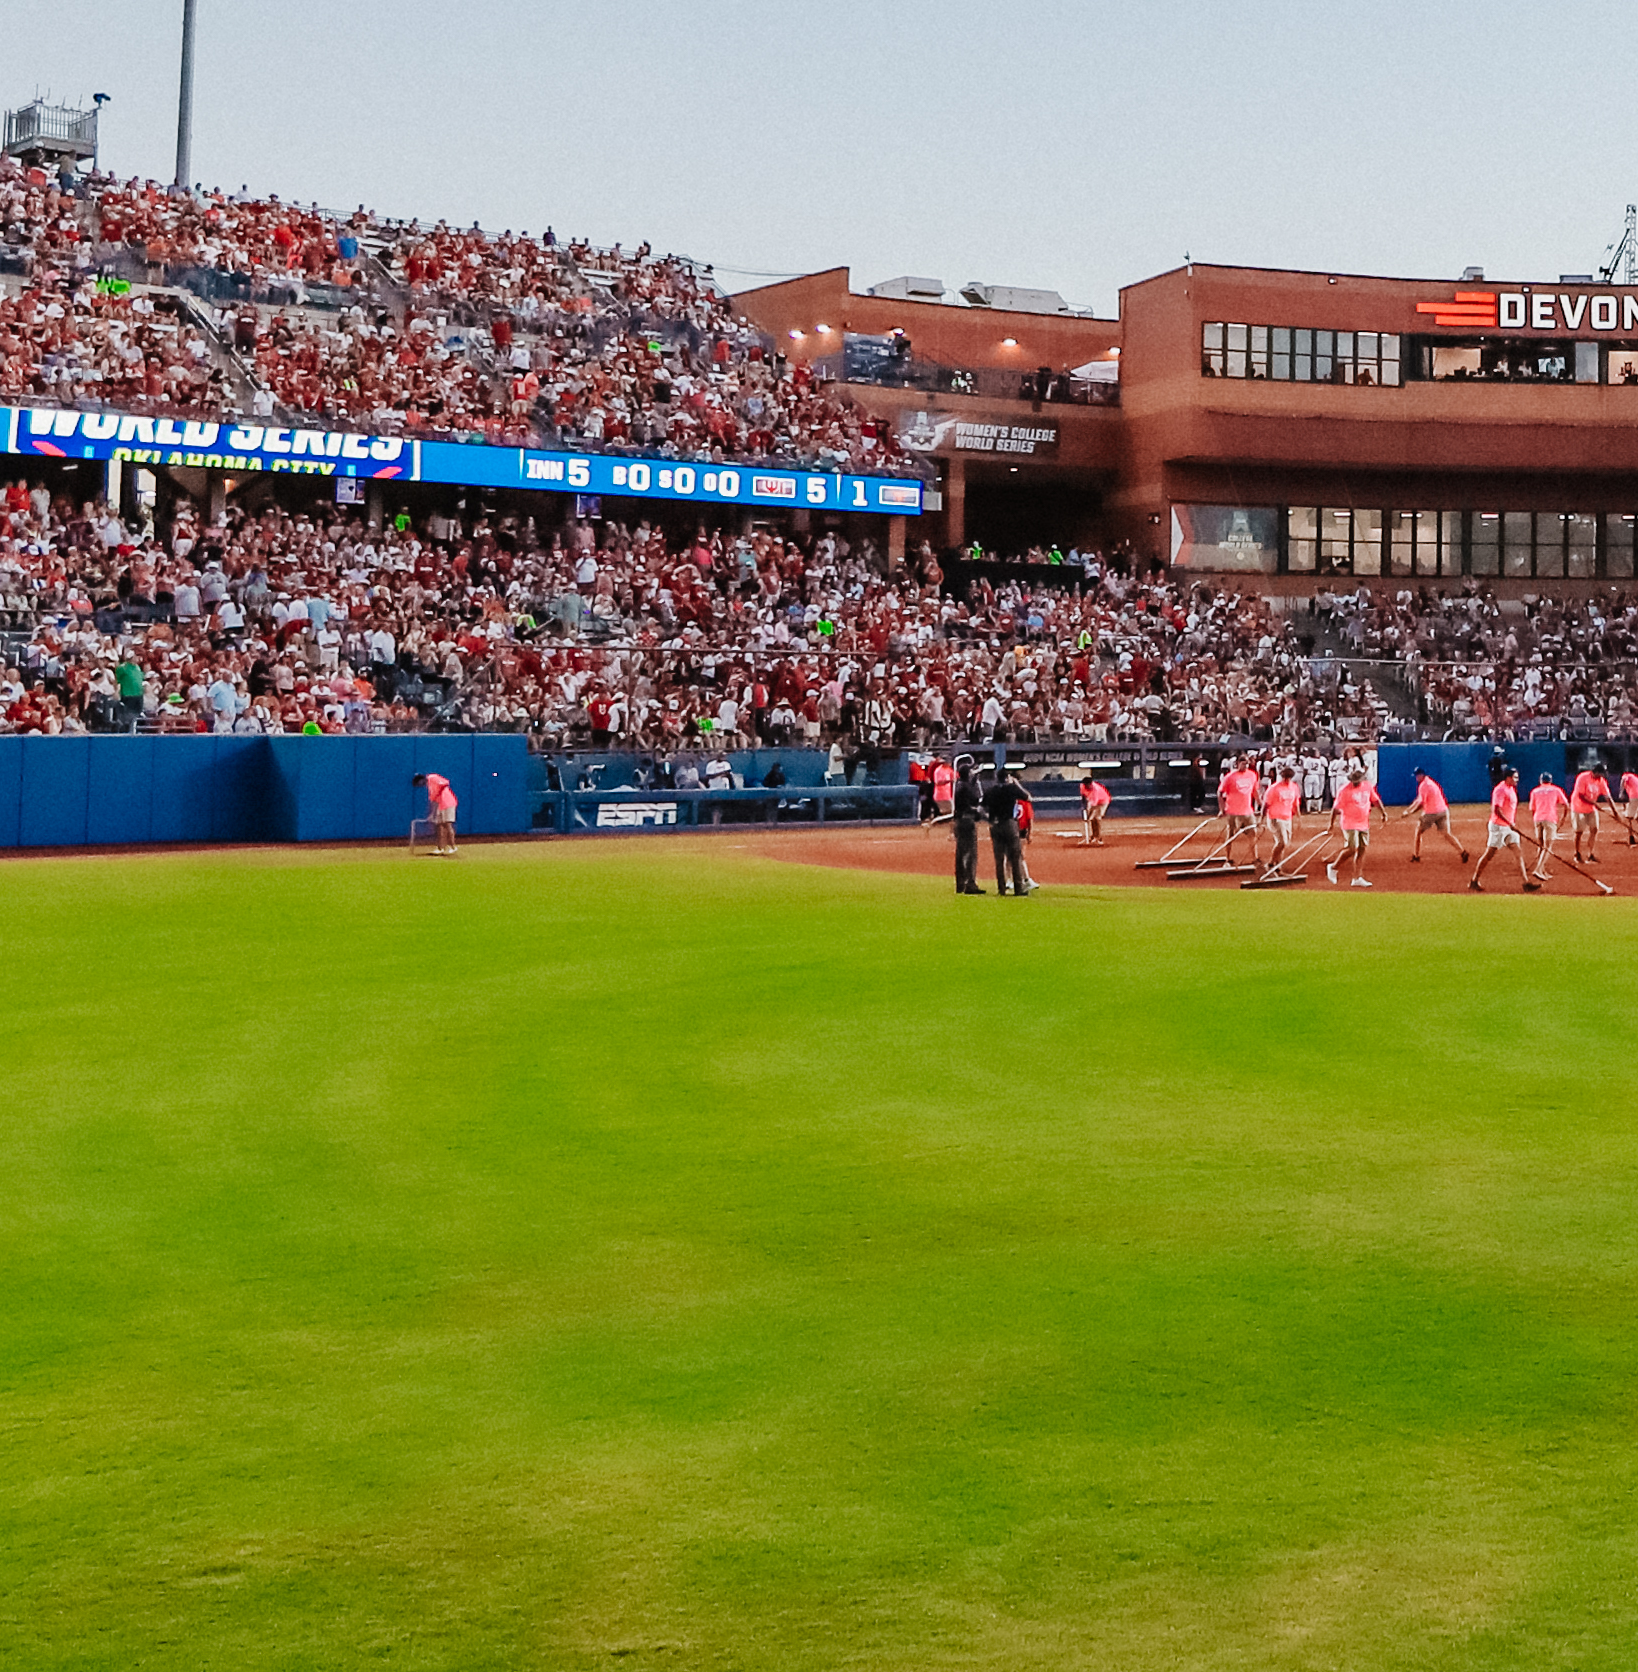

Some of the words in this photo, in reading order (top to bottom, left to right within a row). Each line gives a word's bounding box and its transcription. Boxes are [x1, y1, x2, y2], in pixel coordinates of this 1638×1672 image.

[955, 422, 1009, 438] WOMEN'S
[1012, 427, 1056, 442] COLLEGE
[955, 436, 993, 450] WORLD
[996, 438, 1036, 453] SERIES
[526, 459, 563, 480] INN
[567, 458, 590, 486] 5
[612, 466, 627, 486] B
[628, 463, 650, 491] 0
[659, 469, 673, 489] S
[674, 466, 695, 494] 0
[807, 477, 827, 503] 5
[852, 480, 868, 506] 1
[596, 803, 678, 827] ESPN
